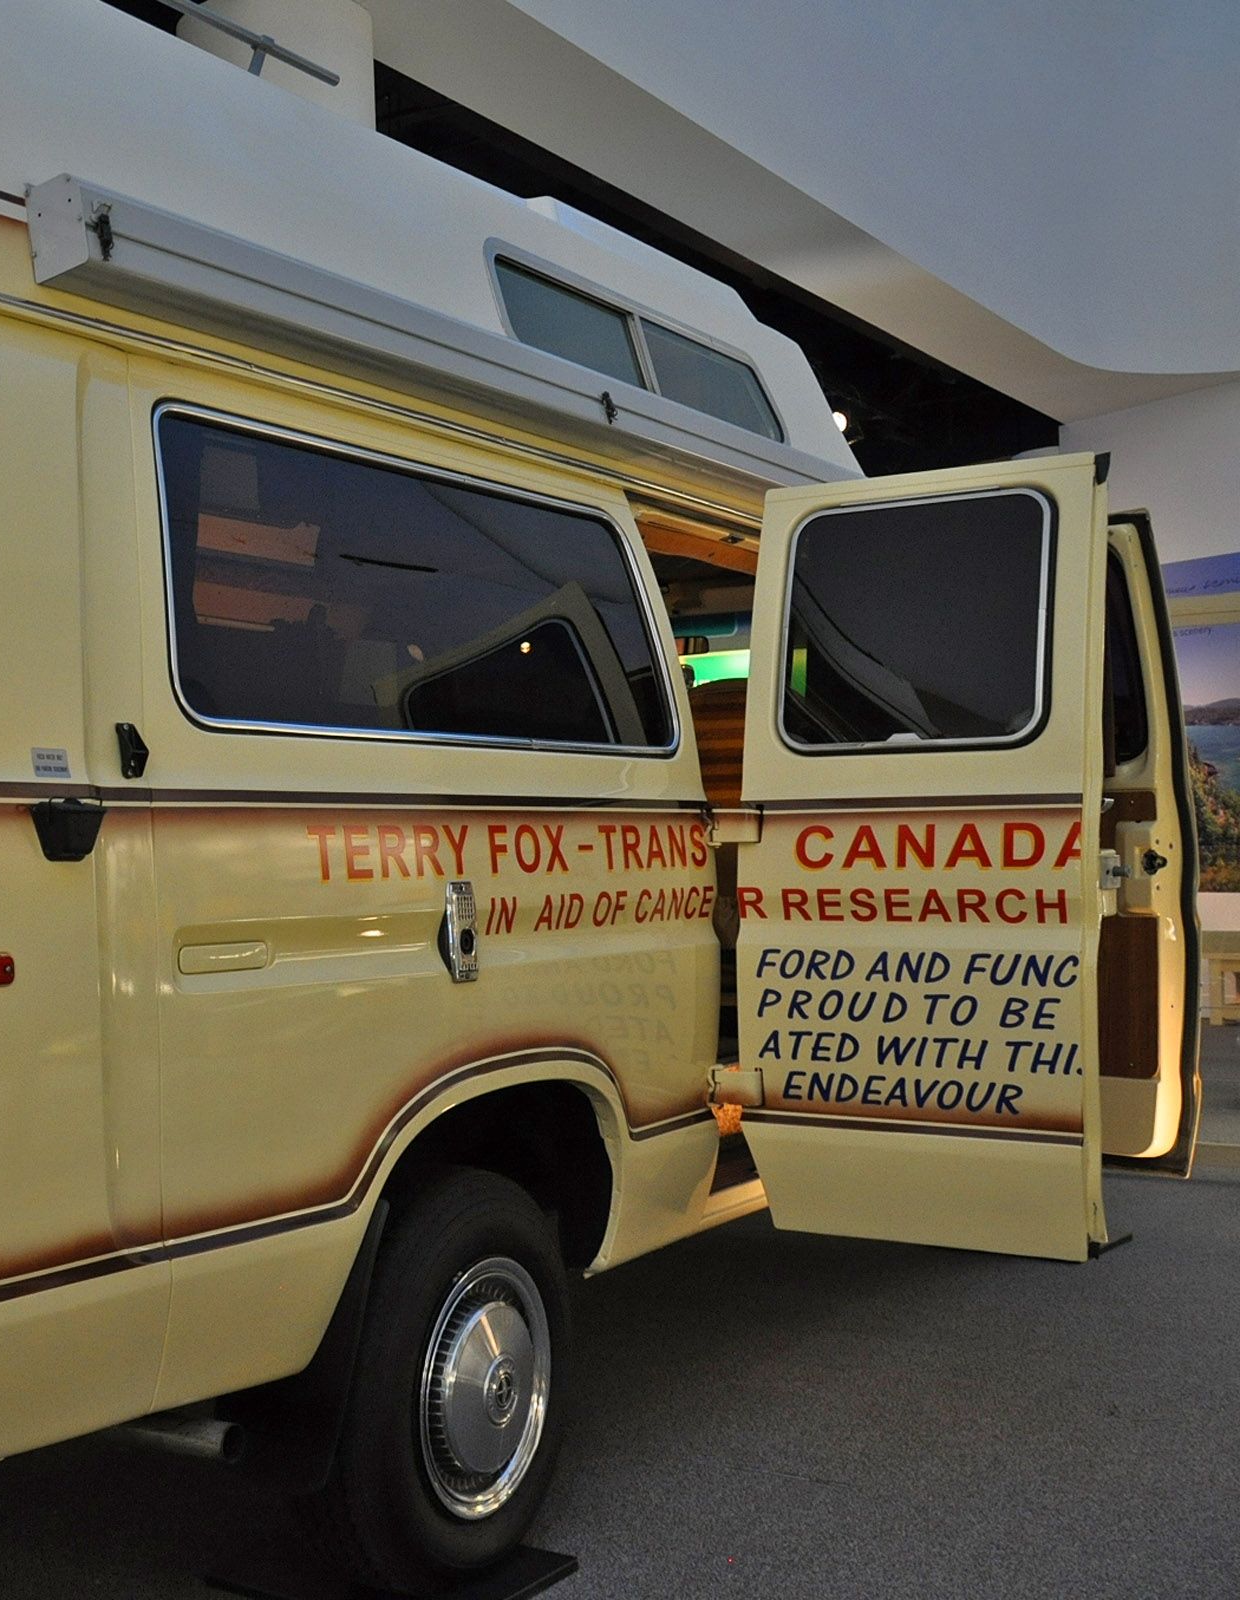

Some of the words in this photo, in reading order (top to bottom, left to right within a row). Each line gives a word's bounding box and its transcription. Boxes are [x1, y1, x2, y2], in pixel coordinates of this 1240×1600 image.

[306, 825, 469, 882] TERRY
[487, 824, 569, 875] FOX
[795, 821, 1082, 871] CANADA
[485, 896, 517, 936] IN
[534, 892, 584, 932] AID
[592, 891, 628, 927] OF
[781, 888, 1068, 924] RESEARCH
[756, 948, 855, 981] FORD
[865, 951, 950, 984] AND
[963, 954, 1079, 988] FUNC
[757, 988, 907, 1024] PROUD
[924, 993, 979, 1026] TO
[999, 998, 1061, 1030] BE
[759, 1030, 860, 1062] ATED
[877, 1035, 989, 1071] WITH
[1004, 1041, 1082, 1076] THI
[782, 1071, 1023, 1116] ENDEAVOUR
